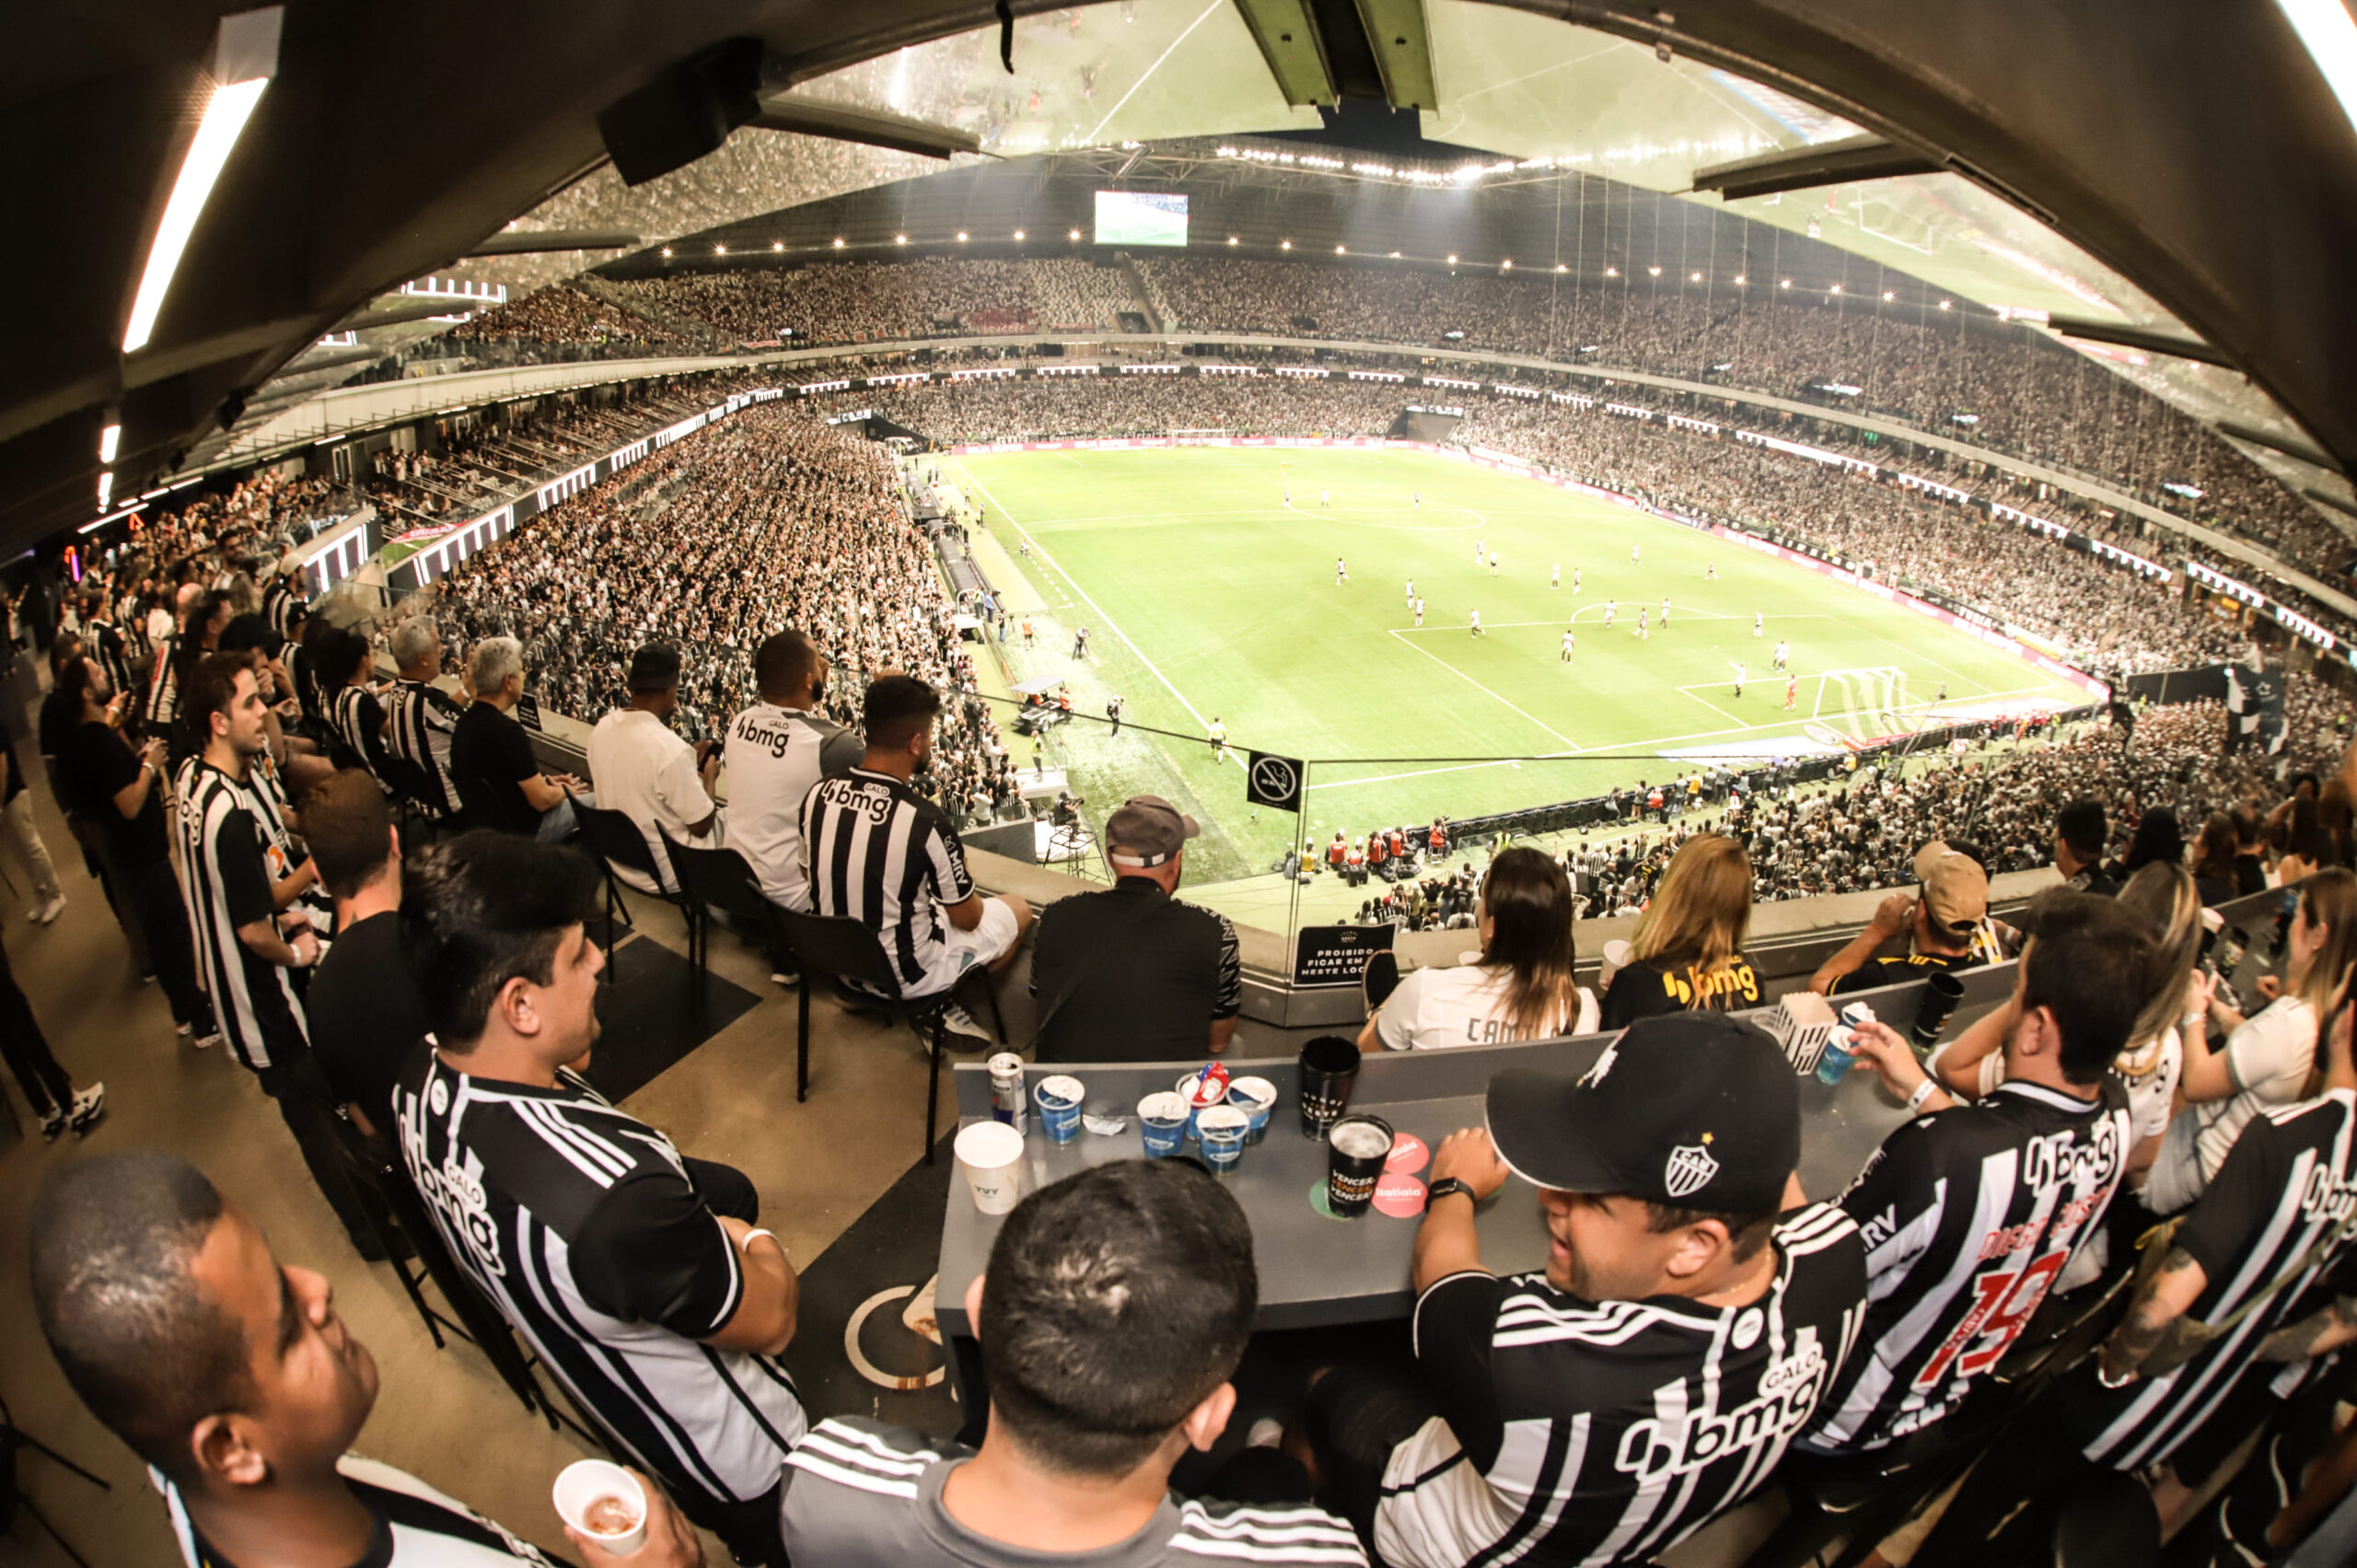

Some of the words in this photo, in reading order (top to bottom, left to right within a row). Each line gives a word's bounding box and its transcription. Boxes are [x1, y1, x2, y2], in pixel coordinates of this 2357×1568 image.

[744, 719, 790, 759] bmg
[768, 720, 790, 730] GALO
[834, 784, 891, 823] bmg
[864, 784, 889, 796] GALO
[949, 850, 969, 884] MRV
[1307, 958, 1344, 967] FICAR
[1317, 948, 1374, 958] PROIBIDO
[1301, 968, 1339, 976] NESTE
[1687, 965, 1759, 1002] bmg
[1678, 1151, 1709, 1169] CAN
[447, 1163, 483, 1204] GALO
[1859, 1202, 1897, 1253] RV
[1763, 1350, 1818, 1387] GALO
